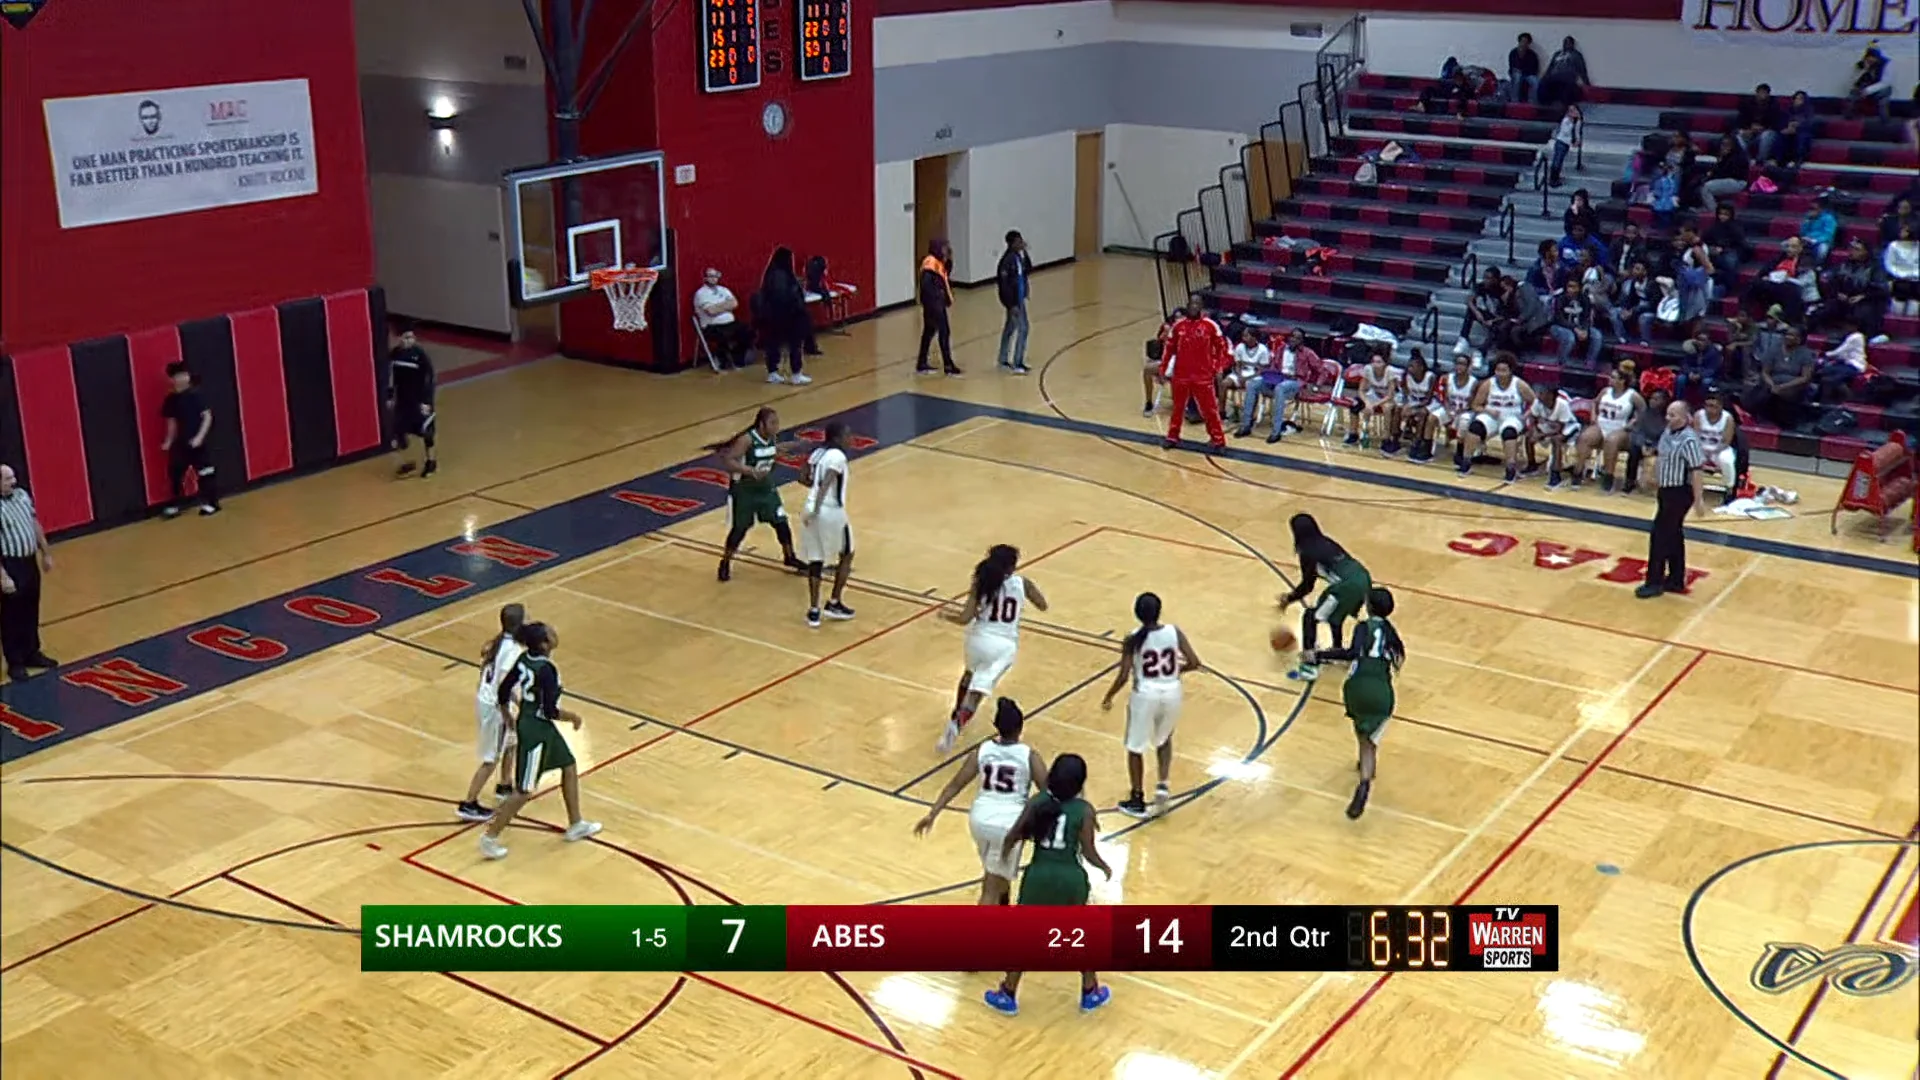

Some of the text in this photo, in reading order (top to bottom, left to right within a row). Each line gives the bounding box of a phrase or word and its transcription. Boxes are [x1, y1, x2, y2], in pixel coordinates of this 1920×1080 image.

[711, 11, 725, 26] 11
[712, 28, 725, 47] 15
[709, 49, 725, 68] 23
[72, 154, 97, 170] ONE
[100, 151, 127, 166] MAN
[128, 143, 197, 163] PRACTICING
[197, 133, 287, 155] SPORTSMANSHIP
[69, 172, 95, 187] FAR
[96, 165, 139, 184] BETTER
[140, 162, 174, 179] THAN
[184, 155, 237, 173] HUNDRED
[238, 148, 290, 167] TEACHING
[988, 596, 1017, 623] 10
[1142, 648, 1178, 678] 23
[982, 763, 1016, 793] 15
